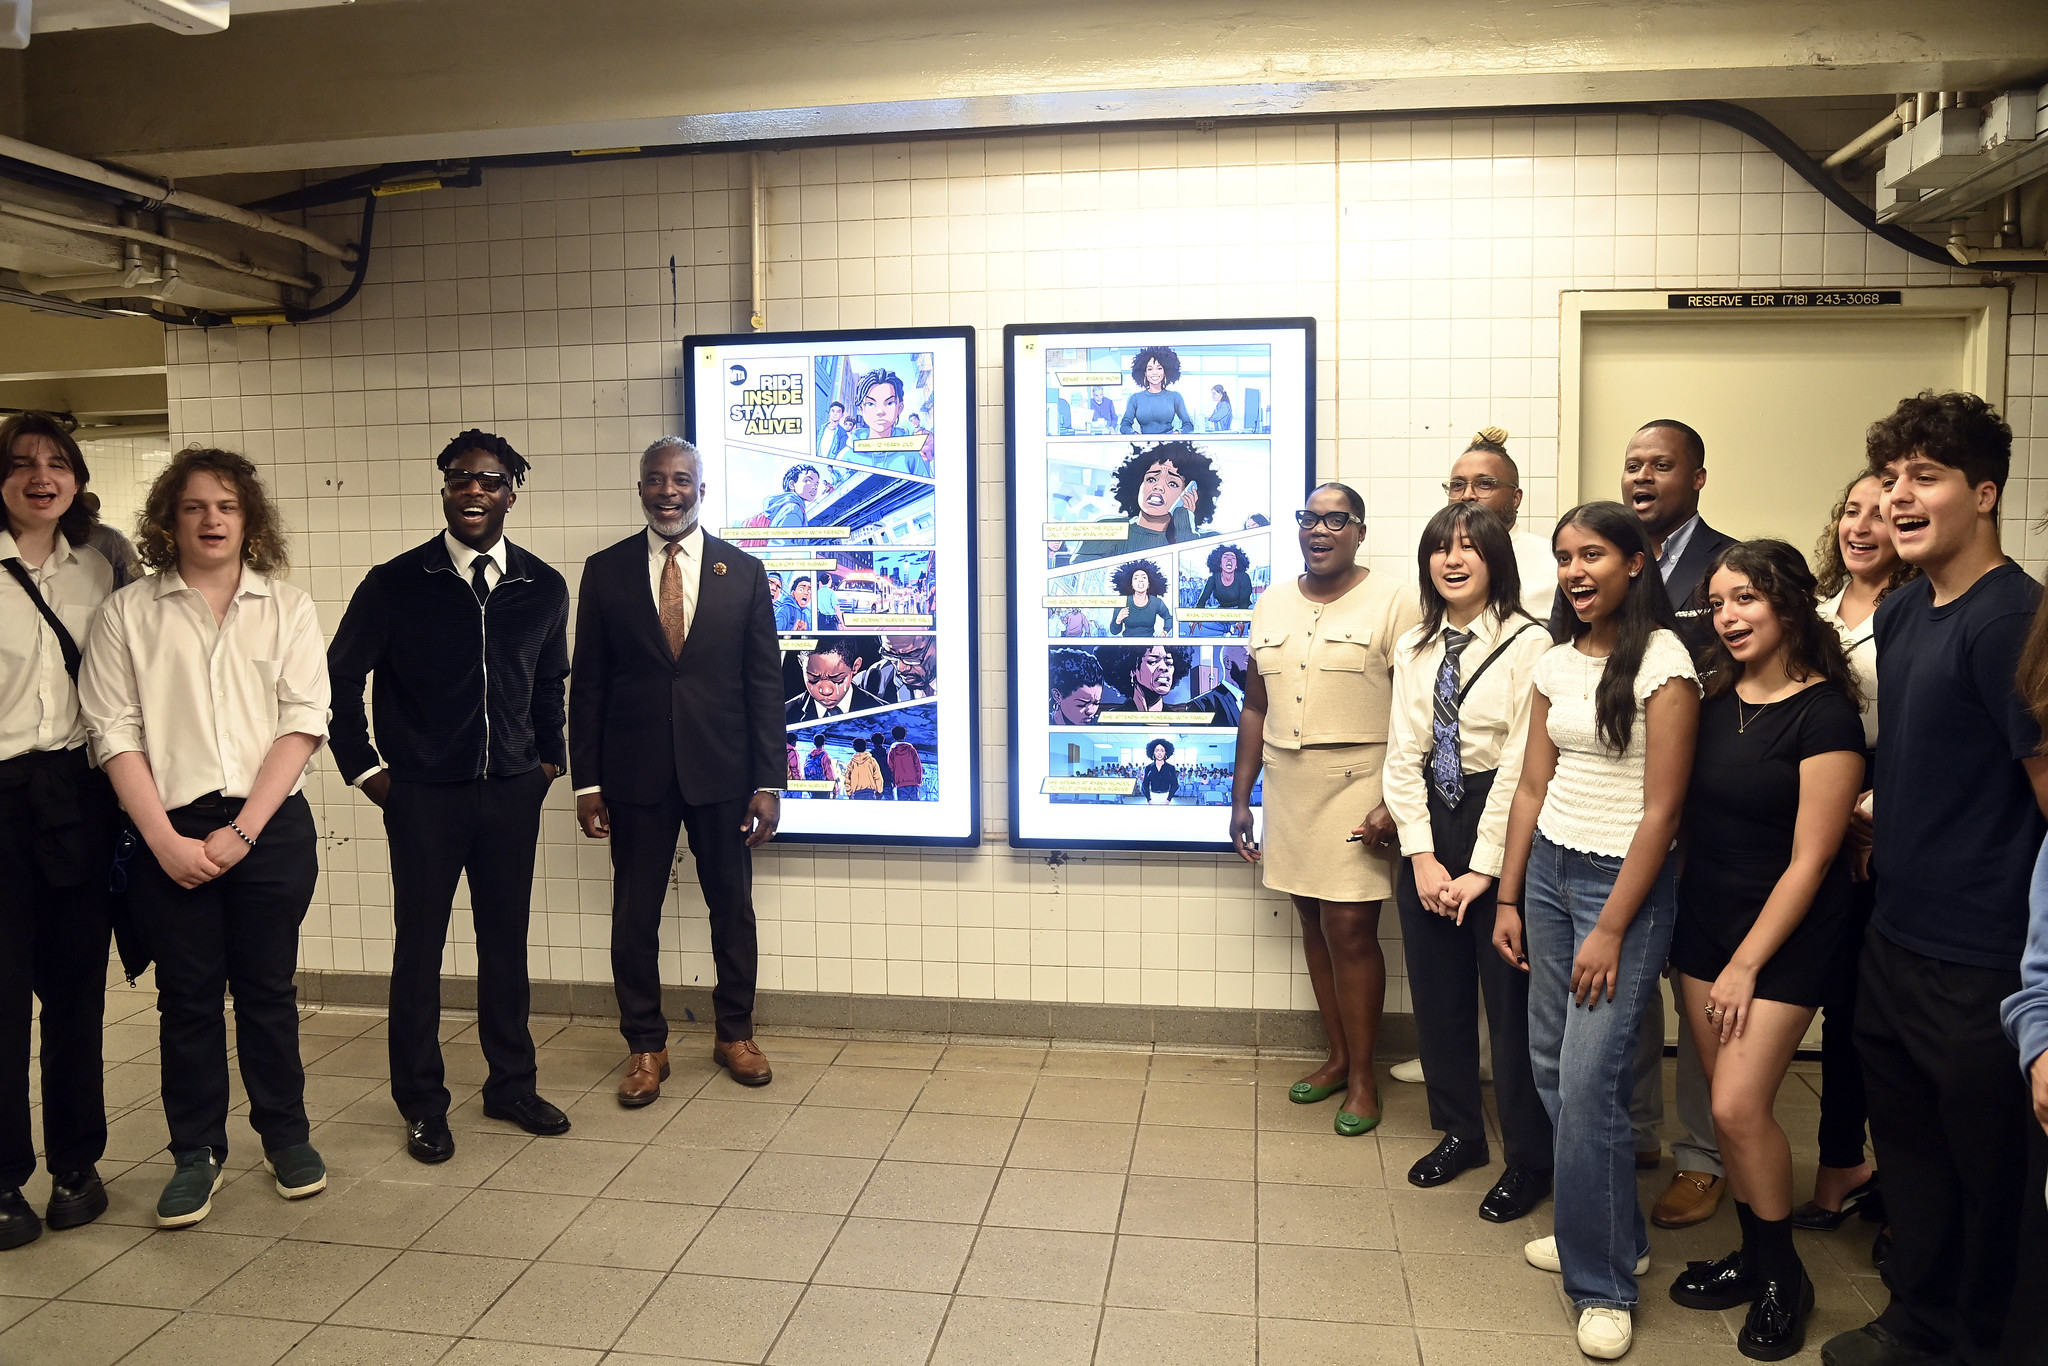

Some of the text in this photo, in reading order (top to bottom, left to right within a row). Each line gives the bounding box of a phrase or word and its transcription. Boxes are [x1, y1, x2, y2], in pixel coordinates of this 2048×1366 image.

[1688, 293, 1880, 307] RESERVE EDR (718) 243-3068
[760, 374, 803, 390] RIDE
[743, 390, 803, 405] INSIDE
[730, 404, 777, 421] STAY
[744, 418, 802, 435] ALIVE!
